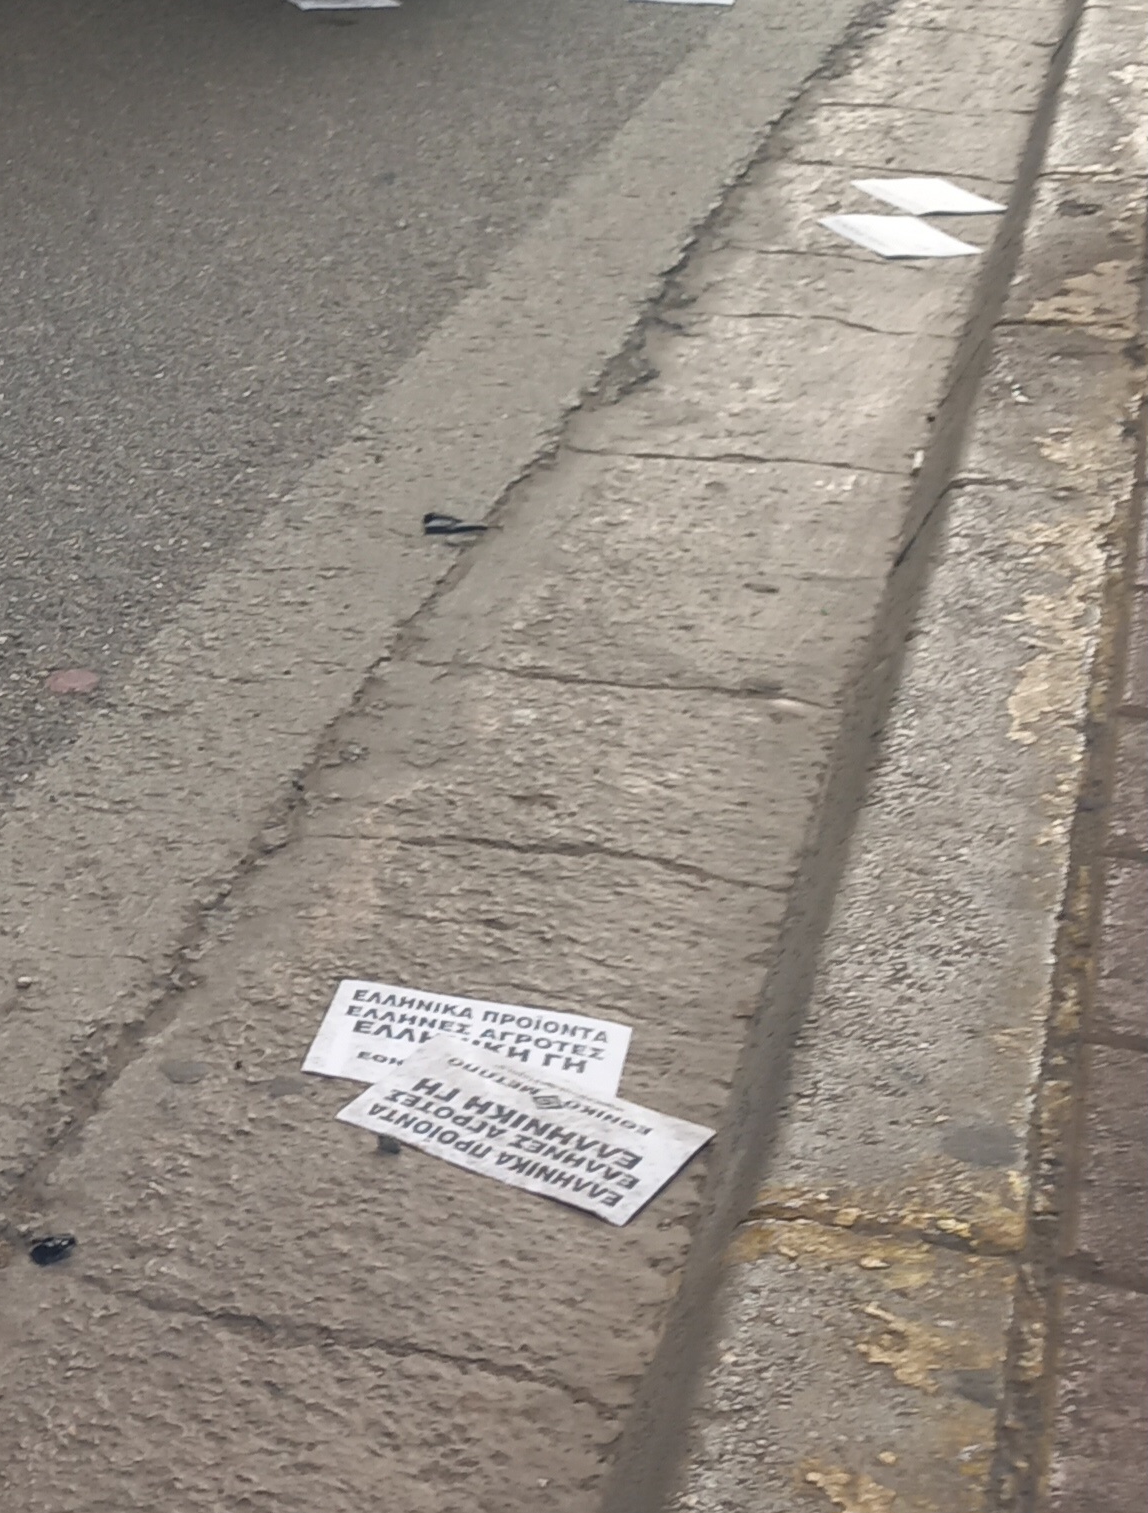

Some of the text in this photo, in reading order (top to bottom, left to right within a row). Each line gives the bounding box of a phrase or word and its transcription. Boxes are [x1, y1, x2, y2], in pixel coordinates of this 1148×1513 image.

[352, 989, 473, 1018] ΕΛΛΗΝΙΚΑ
[345, 1005, 605, 1060] ΕΛΛΗΝΕΣ ΑΓΡΟΤΕΣ
[412, 1078, 461, 1102] ΓΗ
[542, 1053, 588, 1073] ΓΗ
[384, 1089, 640, 1189] ΕΛΛΗΝΕΣ ΑΓΡΟΤΕΣ
[463, 1096, 643, 1170] ΕΛΛΗΝΙΚΗ
[495, 1152, 624, 1207] ΕΛΛΗΝΙΚΑ
